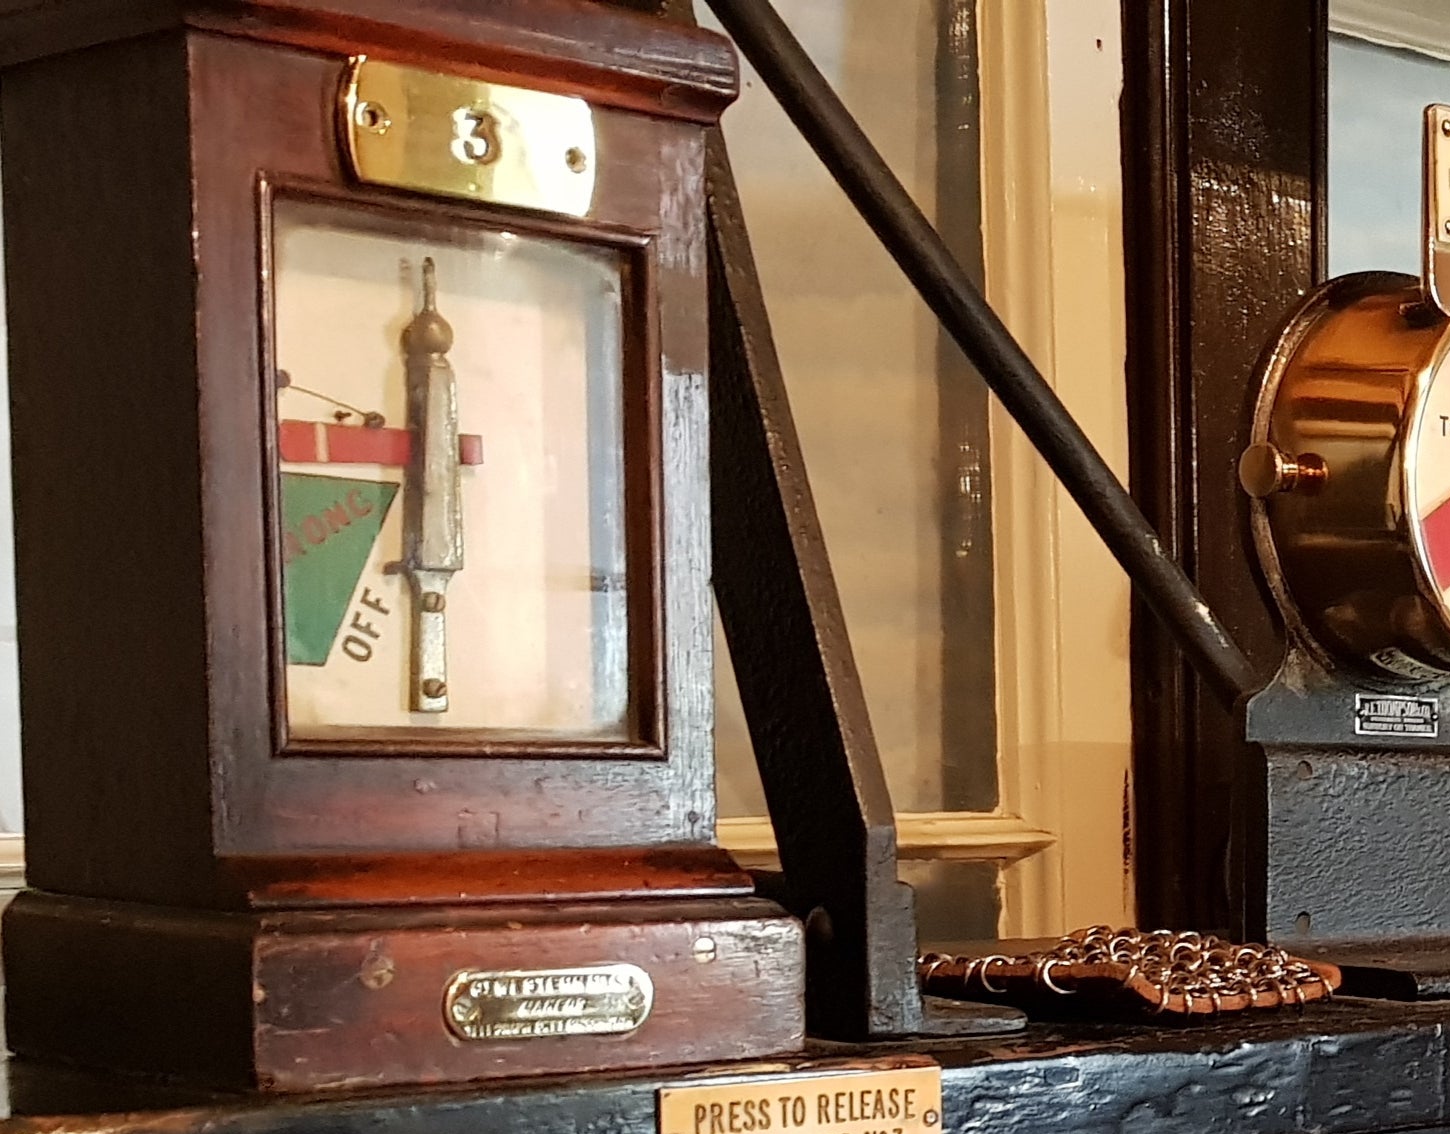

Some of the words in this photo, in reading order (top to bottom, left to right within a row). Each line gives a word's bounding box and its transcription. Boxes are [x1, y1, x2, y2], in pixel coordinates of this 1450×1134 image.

[451, 106, 502, 166] 3
[283, 487, 375, 565] RONG
[341, 586, 391, 663] OFF
[778, 1096, 806, 1129] TO
[817, 1088, 917, 1126] RELEASE
